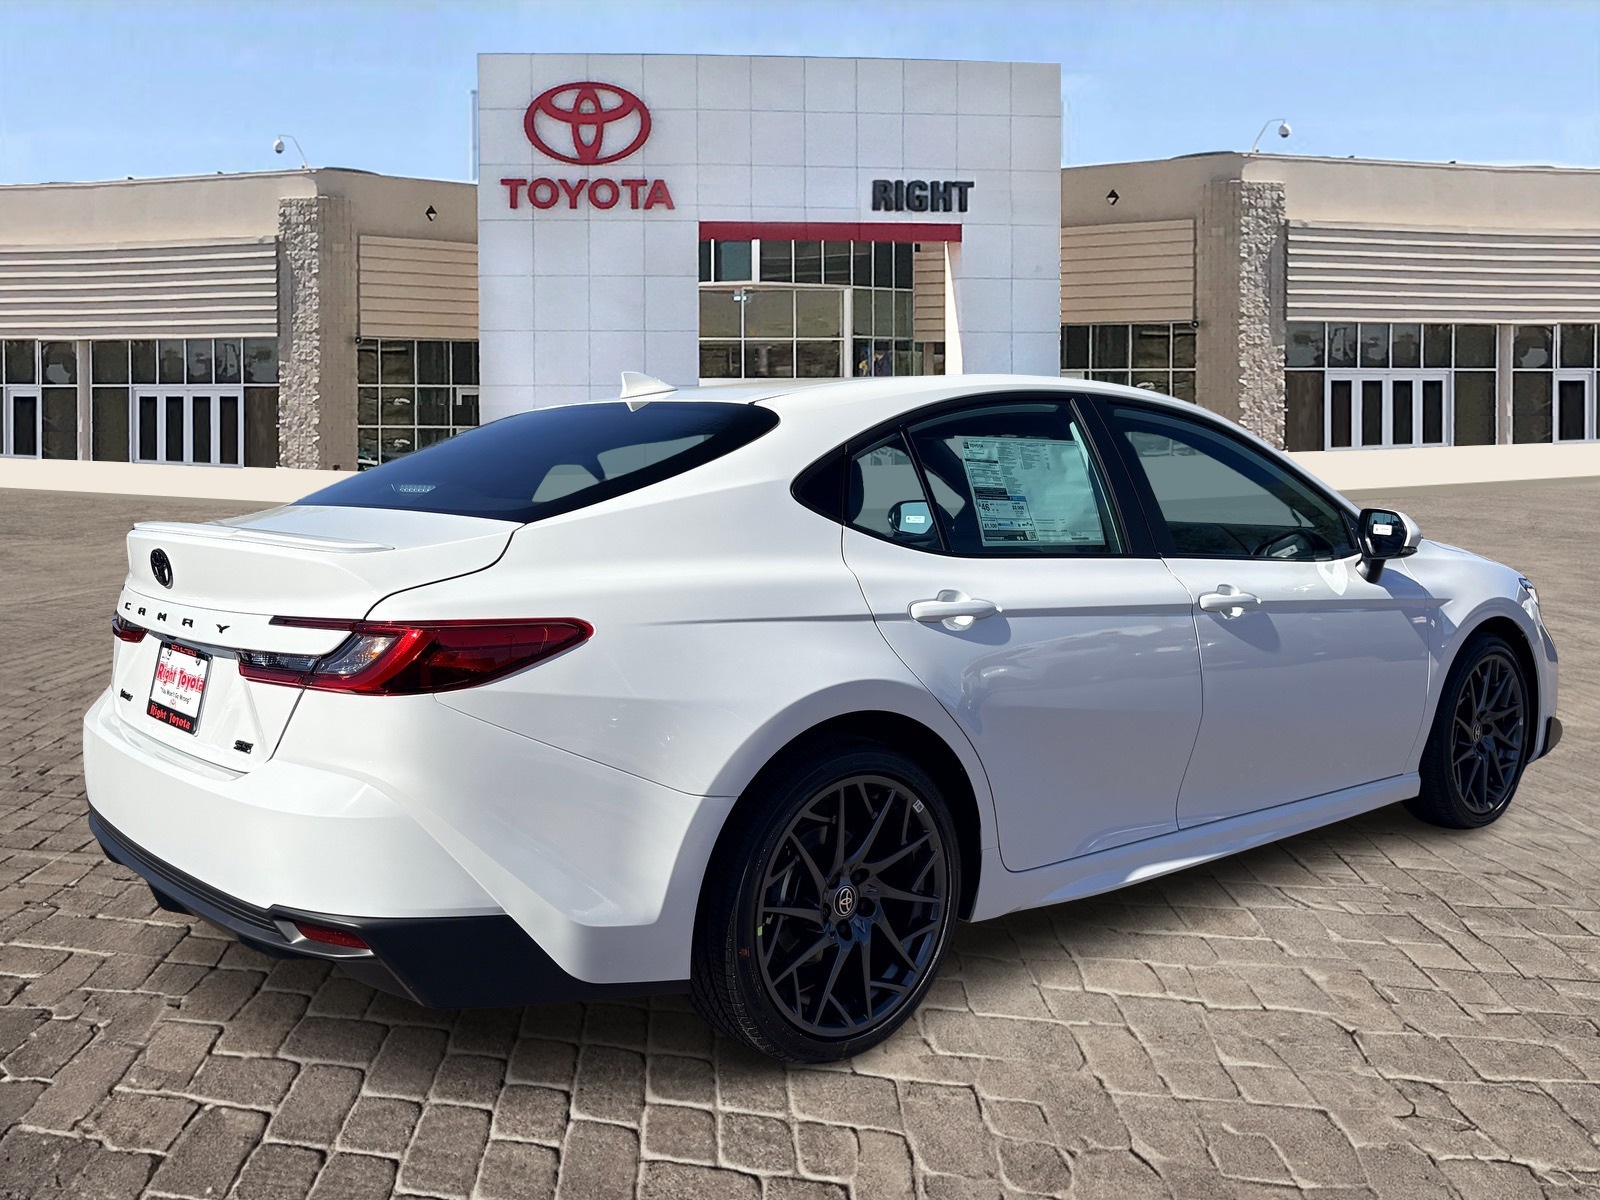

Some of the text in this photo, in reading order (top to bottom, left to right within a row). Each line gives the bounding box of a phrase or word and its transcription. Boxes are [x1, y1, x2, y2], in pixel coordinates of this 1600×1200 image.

[500, 177, 675, 210] TOYOTA
[872, 179, 975, 212] RIGHT
[125, 602, 230, 633] CAMRY
[156, 662, 205, 693] Right Toyota
[150, 704, 191, 730] Right Toyota
